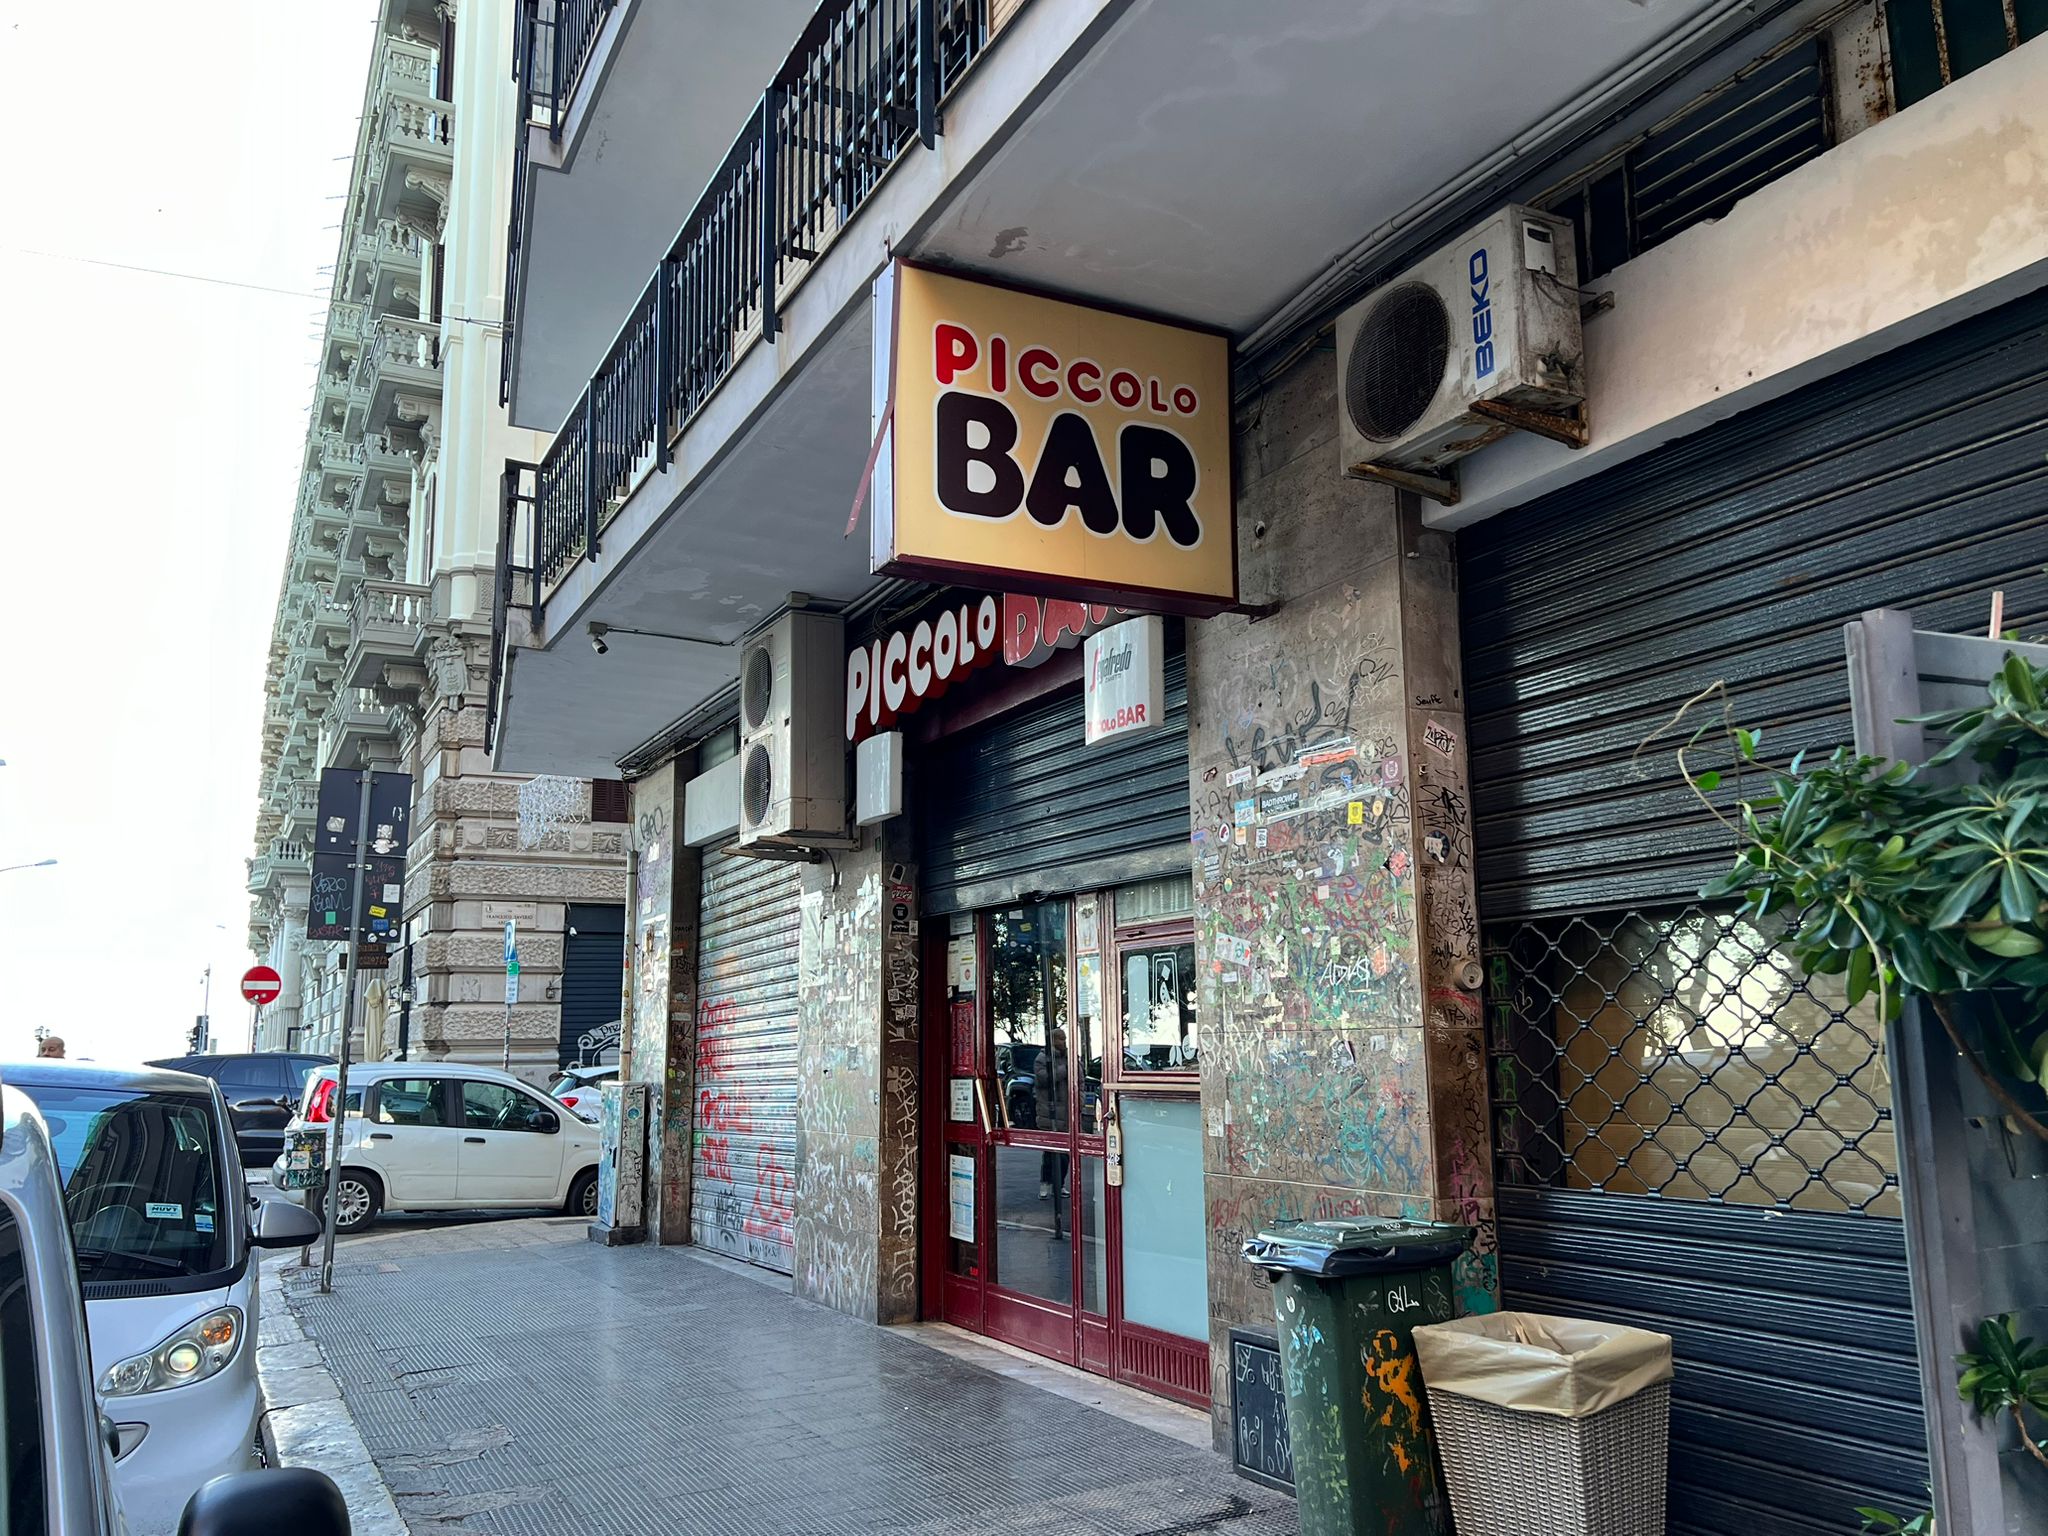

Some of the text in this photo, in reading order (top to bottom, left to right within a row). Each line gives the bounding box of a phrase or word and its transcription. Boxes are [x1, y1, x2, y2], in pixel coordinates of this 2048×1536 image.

[934, 321, 1198, 415] PICCOLO
[1469, 248, 1495, 380] BEKO
[937, 391, 1201, 548] BAR
[846, 595, 997, 741] PICCOLO
[1116, 703, 1146, 728] BAR
